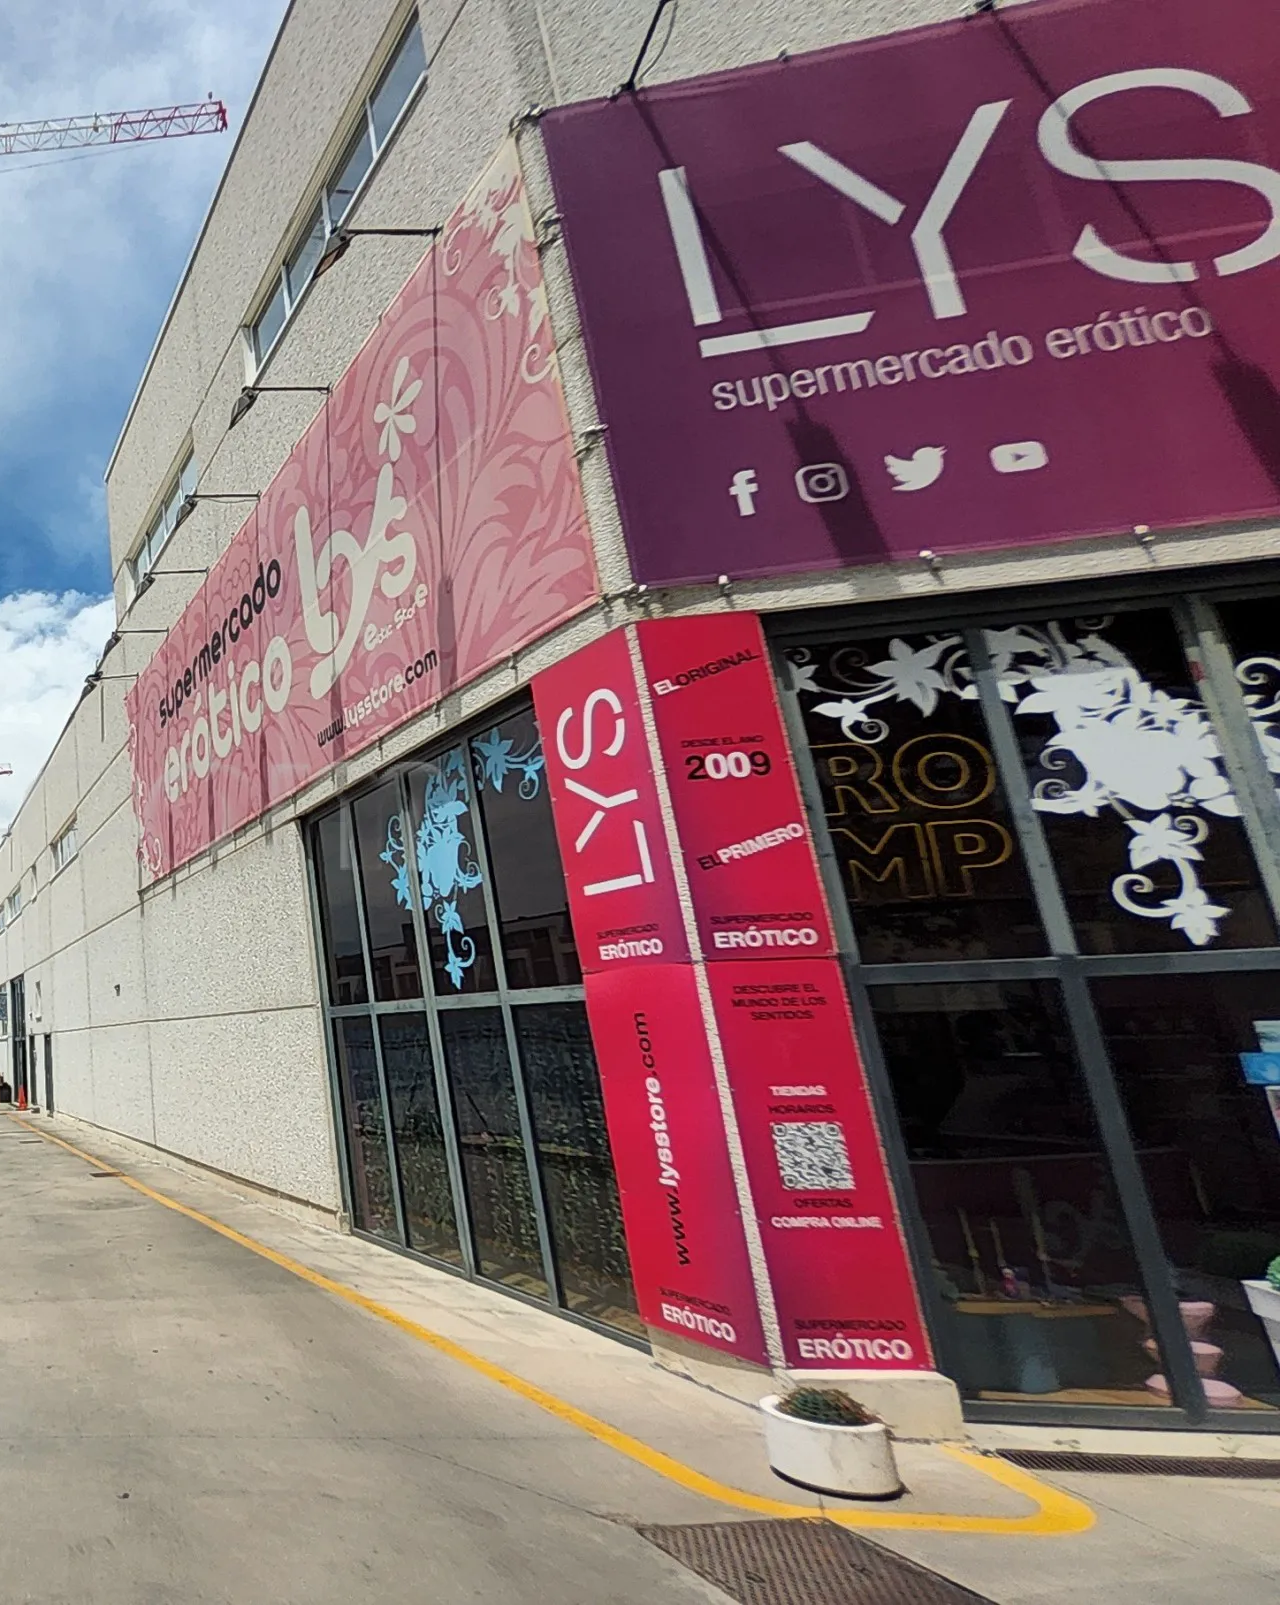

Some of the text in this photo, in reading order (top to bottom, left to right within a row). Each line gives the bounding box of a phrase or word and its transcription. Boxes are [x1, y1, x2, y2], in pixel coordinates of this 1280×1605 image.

[658, 67, 1280, 359] LYS
[712, 304, 1212, 412] supermercado erótico
[159, 558, 282, 729] supermercado
[317, 649, 439, 748] www.lysstore.com
[164, 635, 293, 804] erótico
[684, 750, 771, 780] 2009
[556, 688, 655, 896] LYS
[598, 938, 664, 961] ERÓTICO
[712, 925, 820, 949] ERÓTICO
[730, 996, 828, 1008] MUNDO DE LOS
[732, 983, 821, 995] DESCUBRE EL
[750, 1009, 815, 1021] SENTIDOS
[767, 1103, 837, 1115] HORARIOS
[633, 1012, 692, 1266] www.lysstore.com
[661, 1302, 737, 1343] ERÓTICO
[794, 1319, 907, 1331] SUPERMERCADO
[797, 1332, 914, 1360] ERÓTICO
